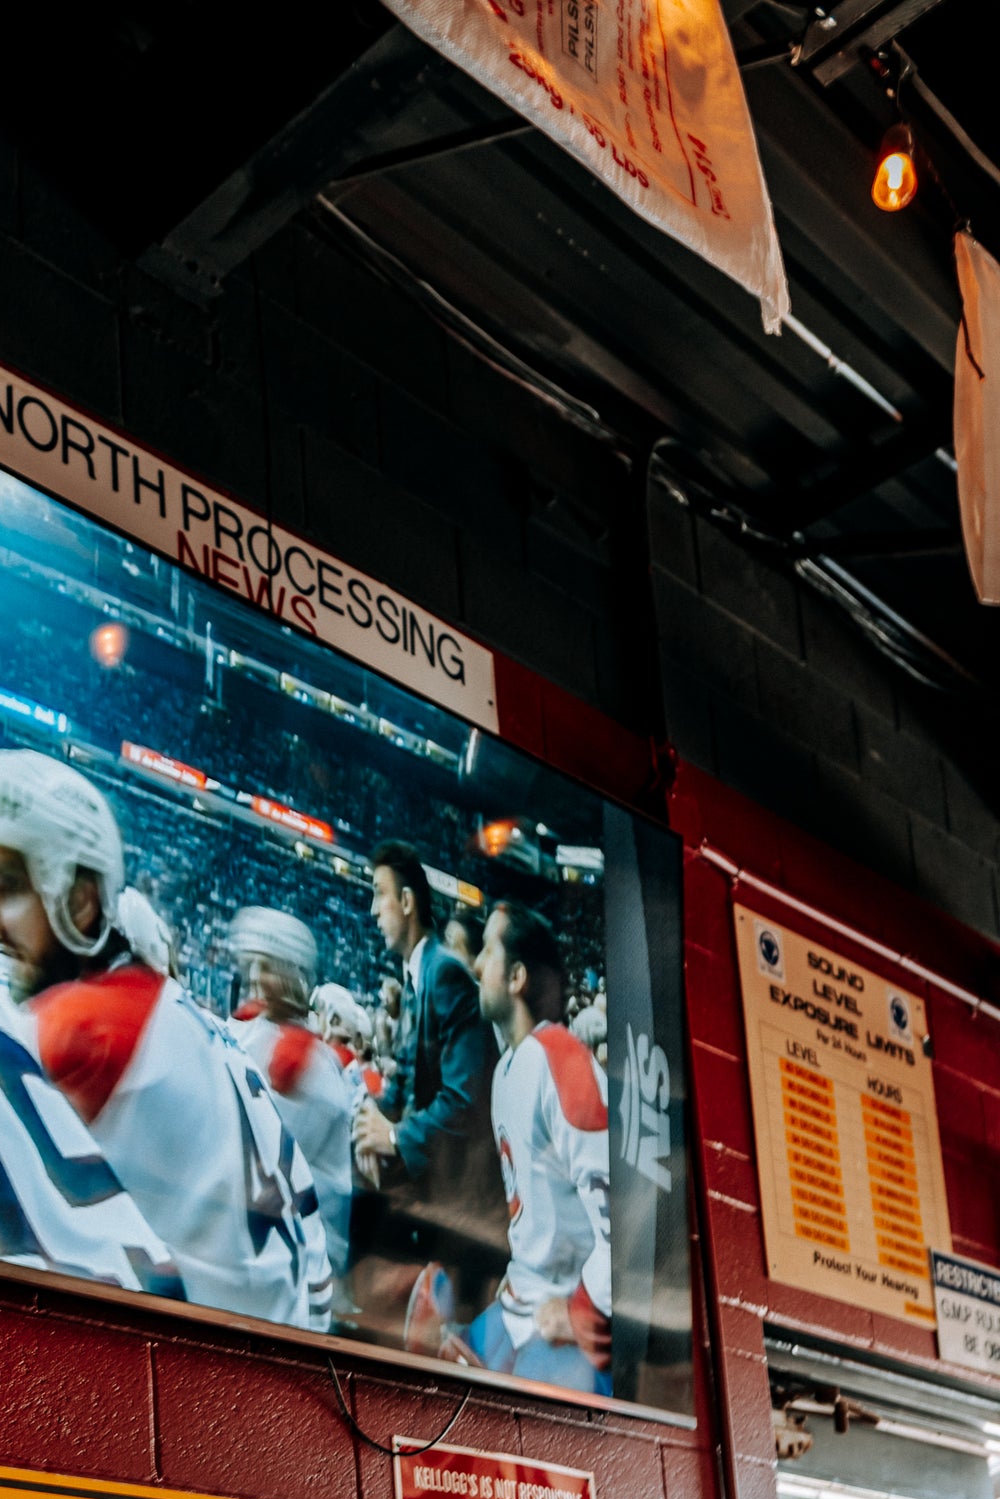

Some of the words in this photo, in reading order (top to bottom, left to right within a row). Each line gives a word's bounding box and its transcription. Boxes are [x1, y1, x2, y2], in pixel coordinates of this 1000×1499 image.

[181, 482, 467, 685] PROCESSING
[807, 951, 864, 992] SOUND
[812, 978, 862, 1017] LEVEL
[769, 984, 858, 1040] EXPOSURE
[866, 1029, 915, 1066] LIMITS
[785, 1039, 820, 1068] LEVEL
[413, 1465, 479, 1498] KELLOGG'S
[479, 1475, 493, 1499] IS
